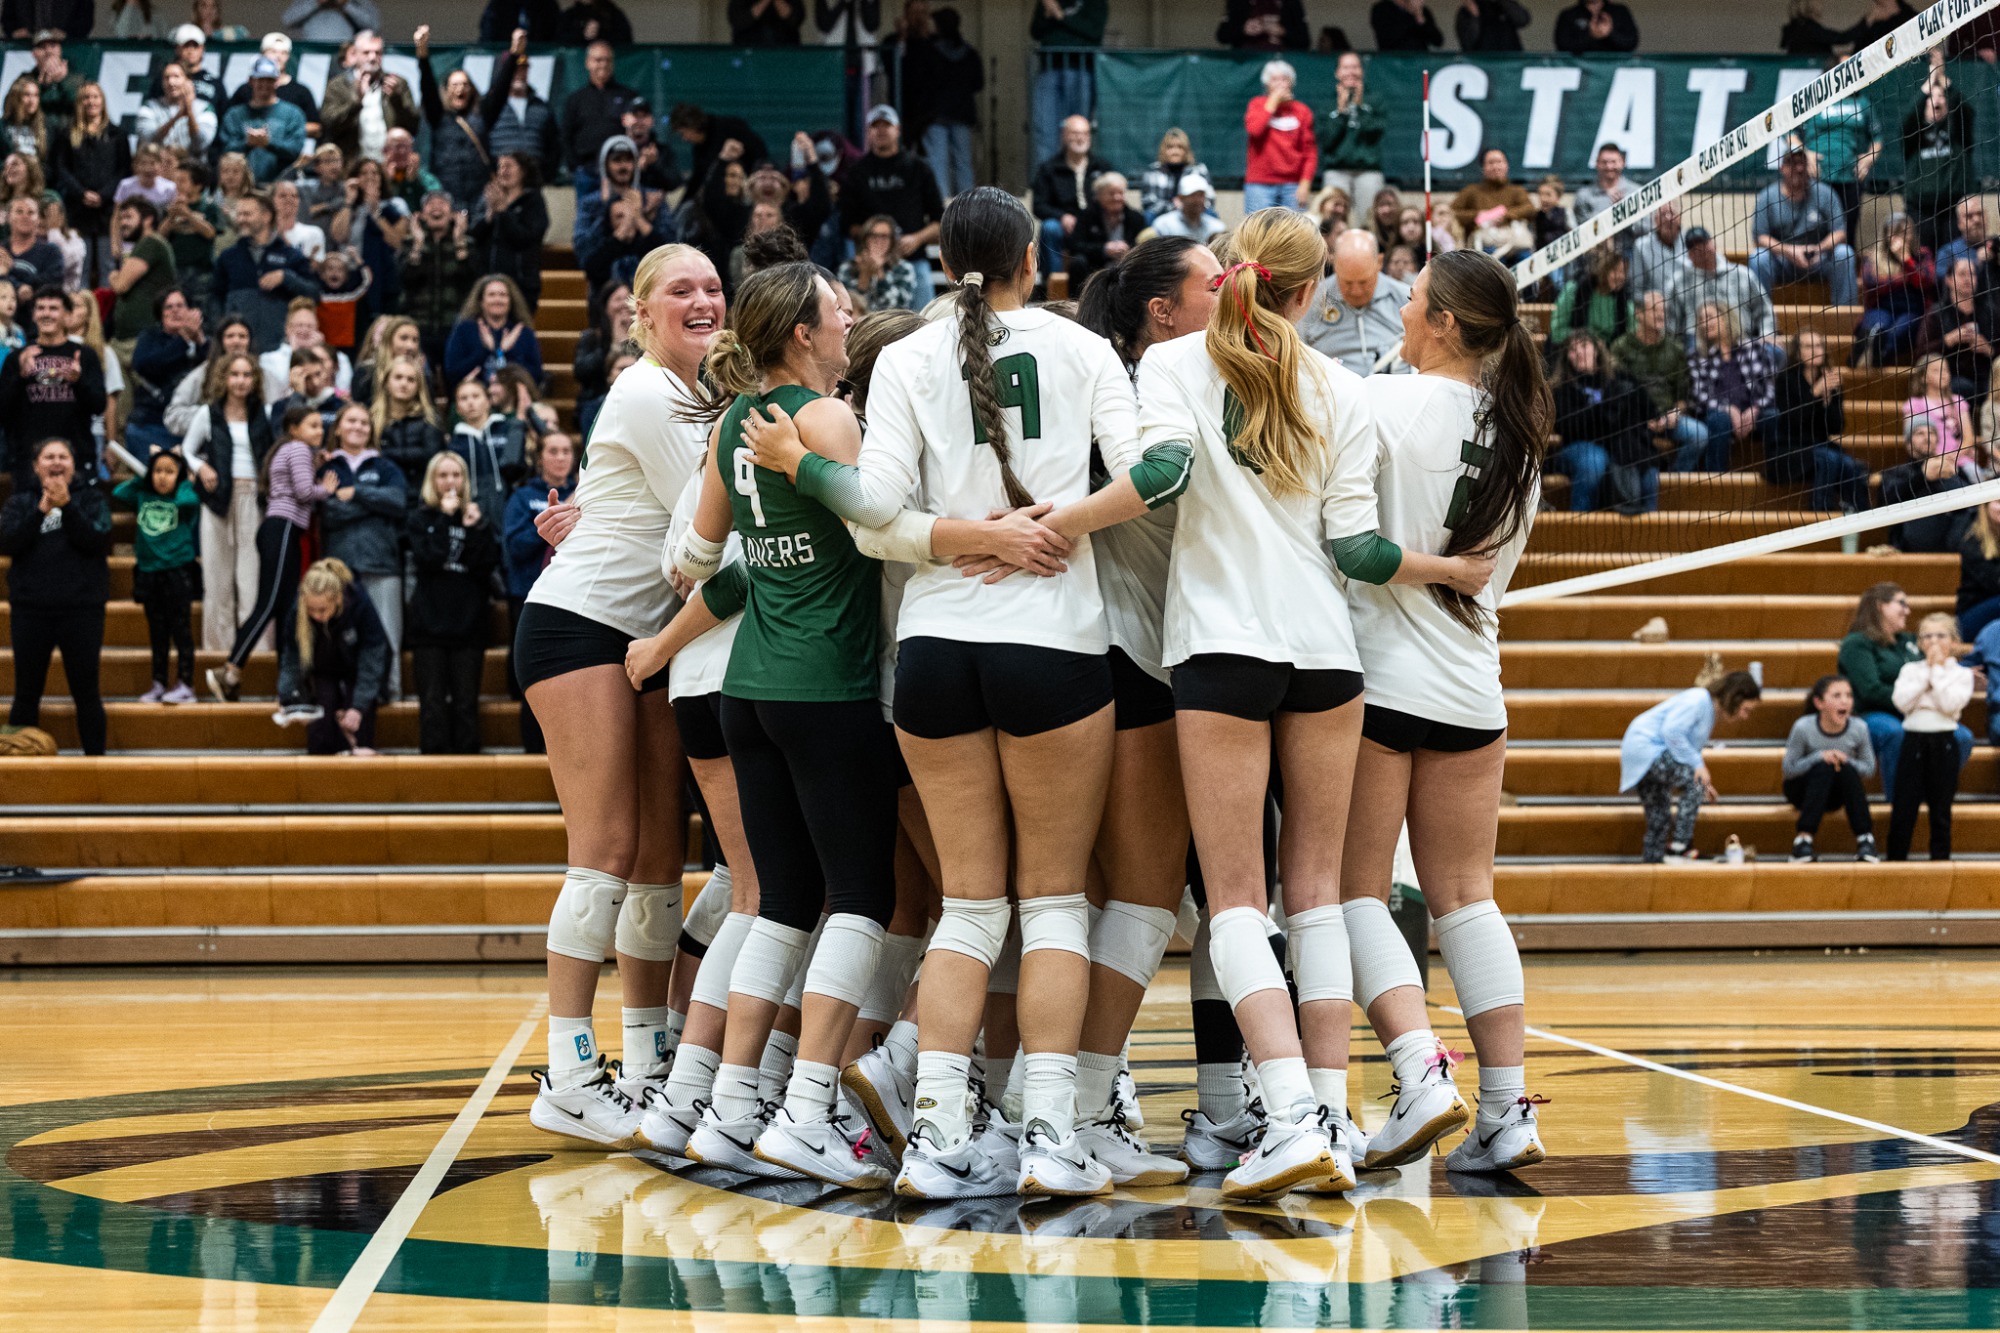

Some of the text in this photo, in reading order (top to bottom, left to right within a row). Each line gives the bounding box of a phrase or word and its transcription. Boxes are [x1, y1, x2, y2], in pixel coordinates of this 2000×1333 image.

[1918, 1, 1945, 40] PLAY
[1792, 52, 1865, 119] BEMIDJI STATE
[1698, 126, 1748, 174] PLAY FOR KU
[1641, 178, 1663, 209] STATE
[732, 446, 768, 528] 9
[741, 531, 816, 568] AVERS
